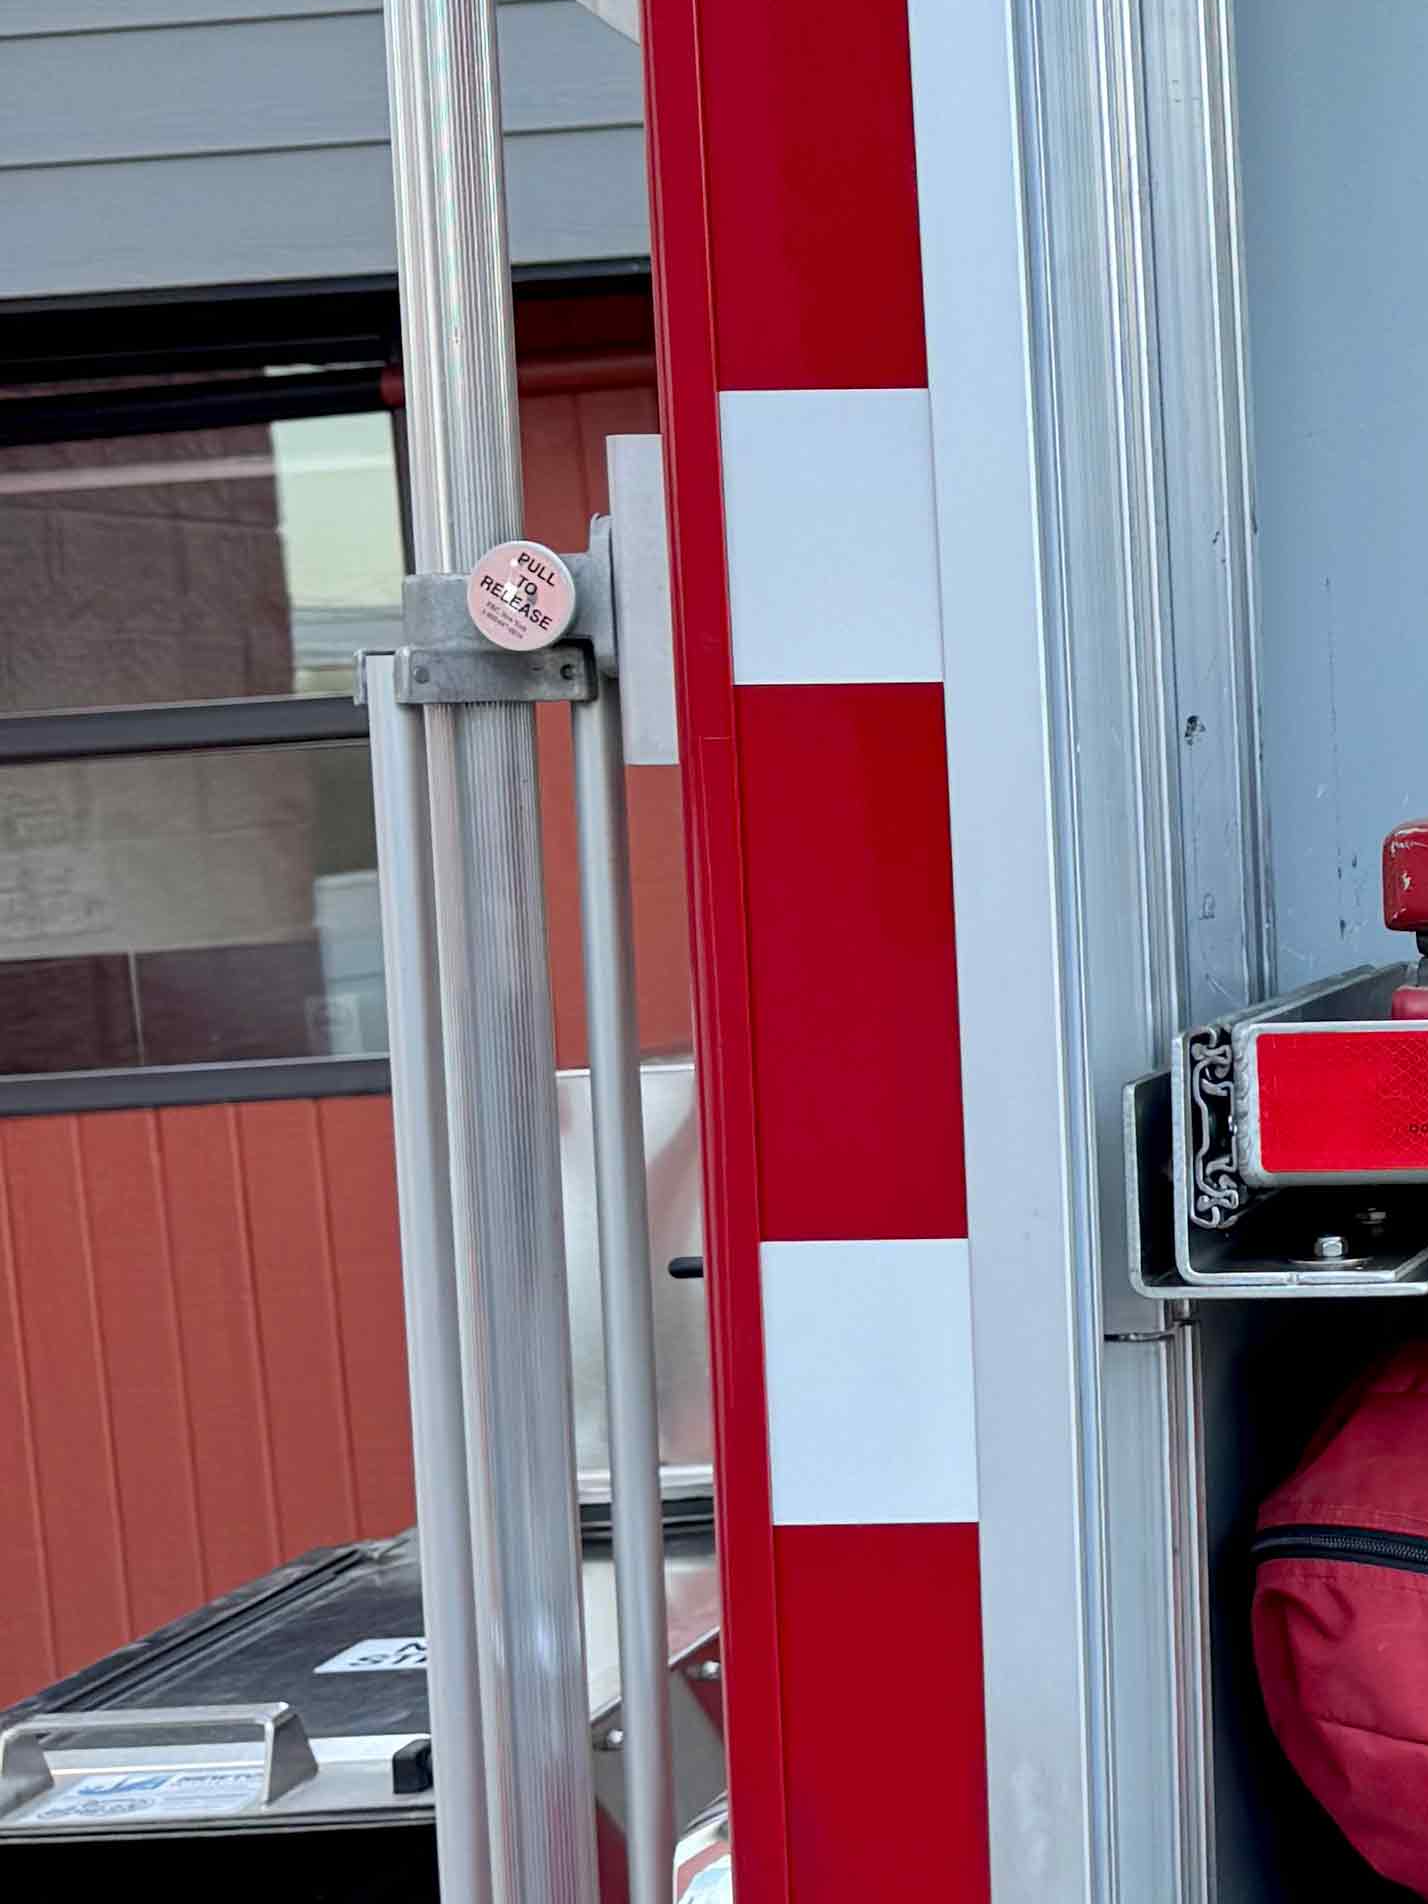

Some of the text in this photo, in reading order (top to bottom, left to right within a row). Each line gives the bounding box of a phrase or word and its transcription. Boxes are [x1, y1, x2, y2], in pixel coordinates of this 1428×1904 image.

[516, 574, 539, 596] TO
[517, 551, 556, 588] PULL
[480, 574, 553, 632] RELEASE
